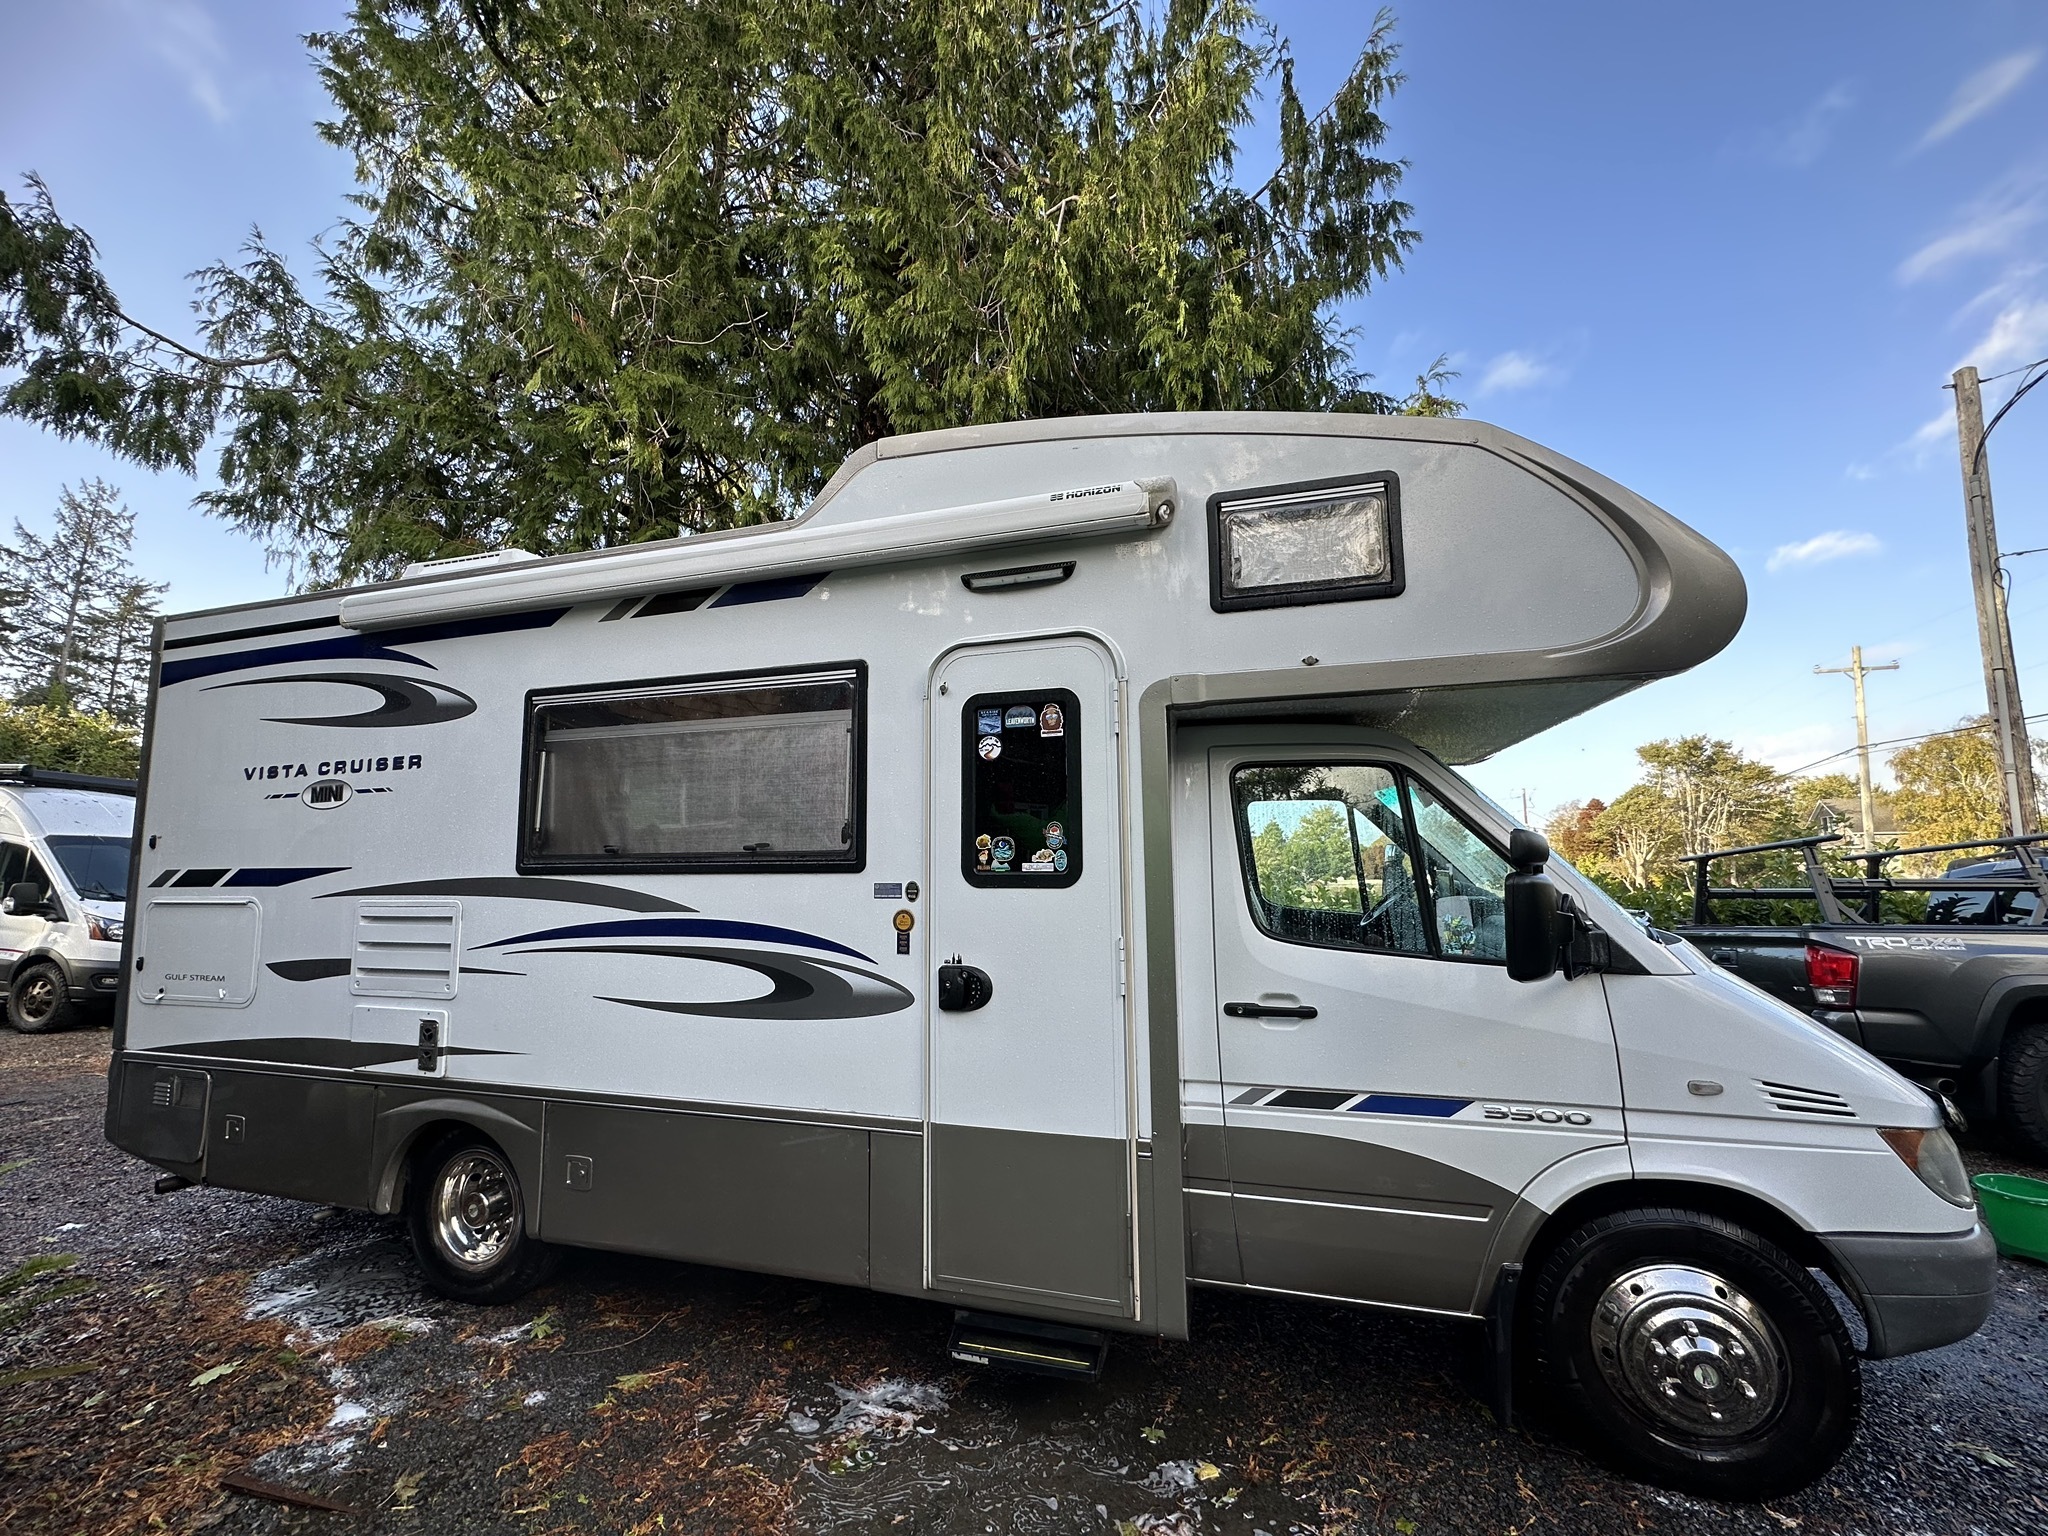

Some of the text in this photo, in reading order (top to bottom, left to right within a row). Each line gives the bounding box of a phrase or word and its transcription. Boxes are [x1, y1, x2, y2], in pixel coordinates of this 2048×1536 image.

[1065, 484, 1121, 500] HORIZON
[243, 754, 423, 781] VISTA CRUISER
[310, 784, 344, 804] MINI
[1845, 936, 1908, 949] TRD
[164, 973, 226, 982] GULF STREAM
[1482, 1103, 1593, 1126] 3500
